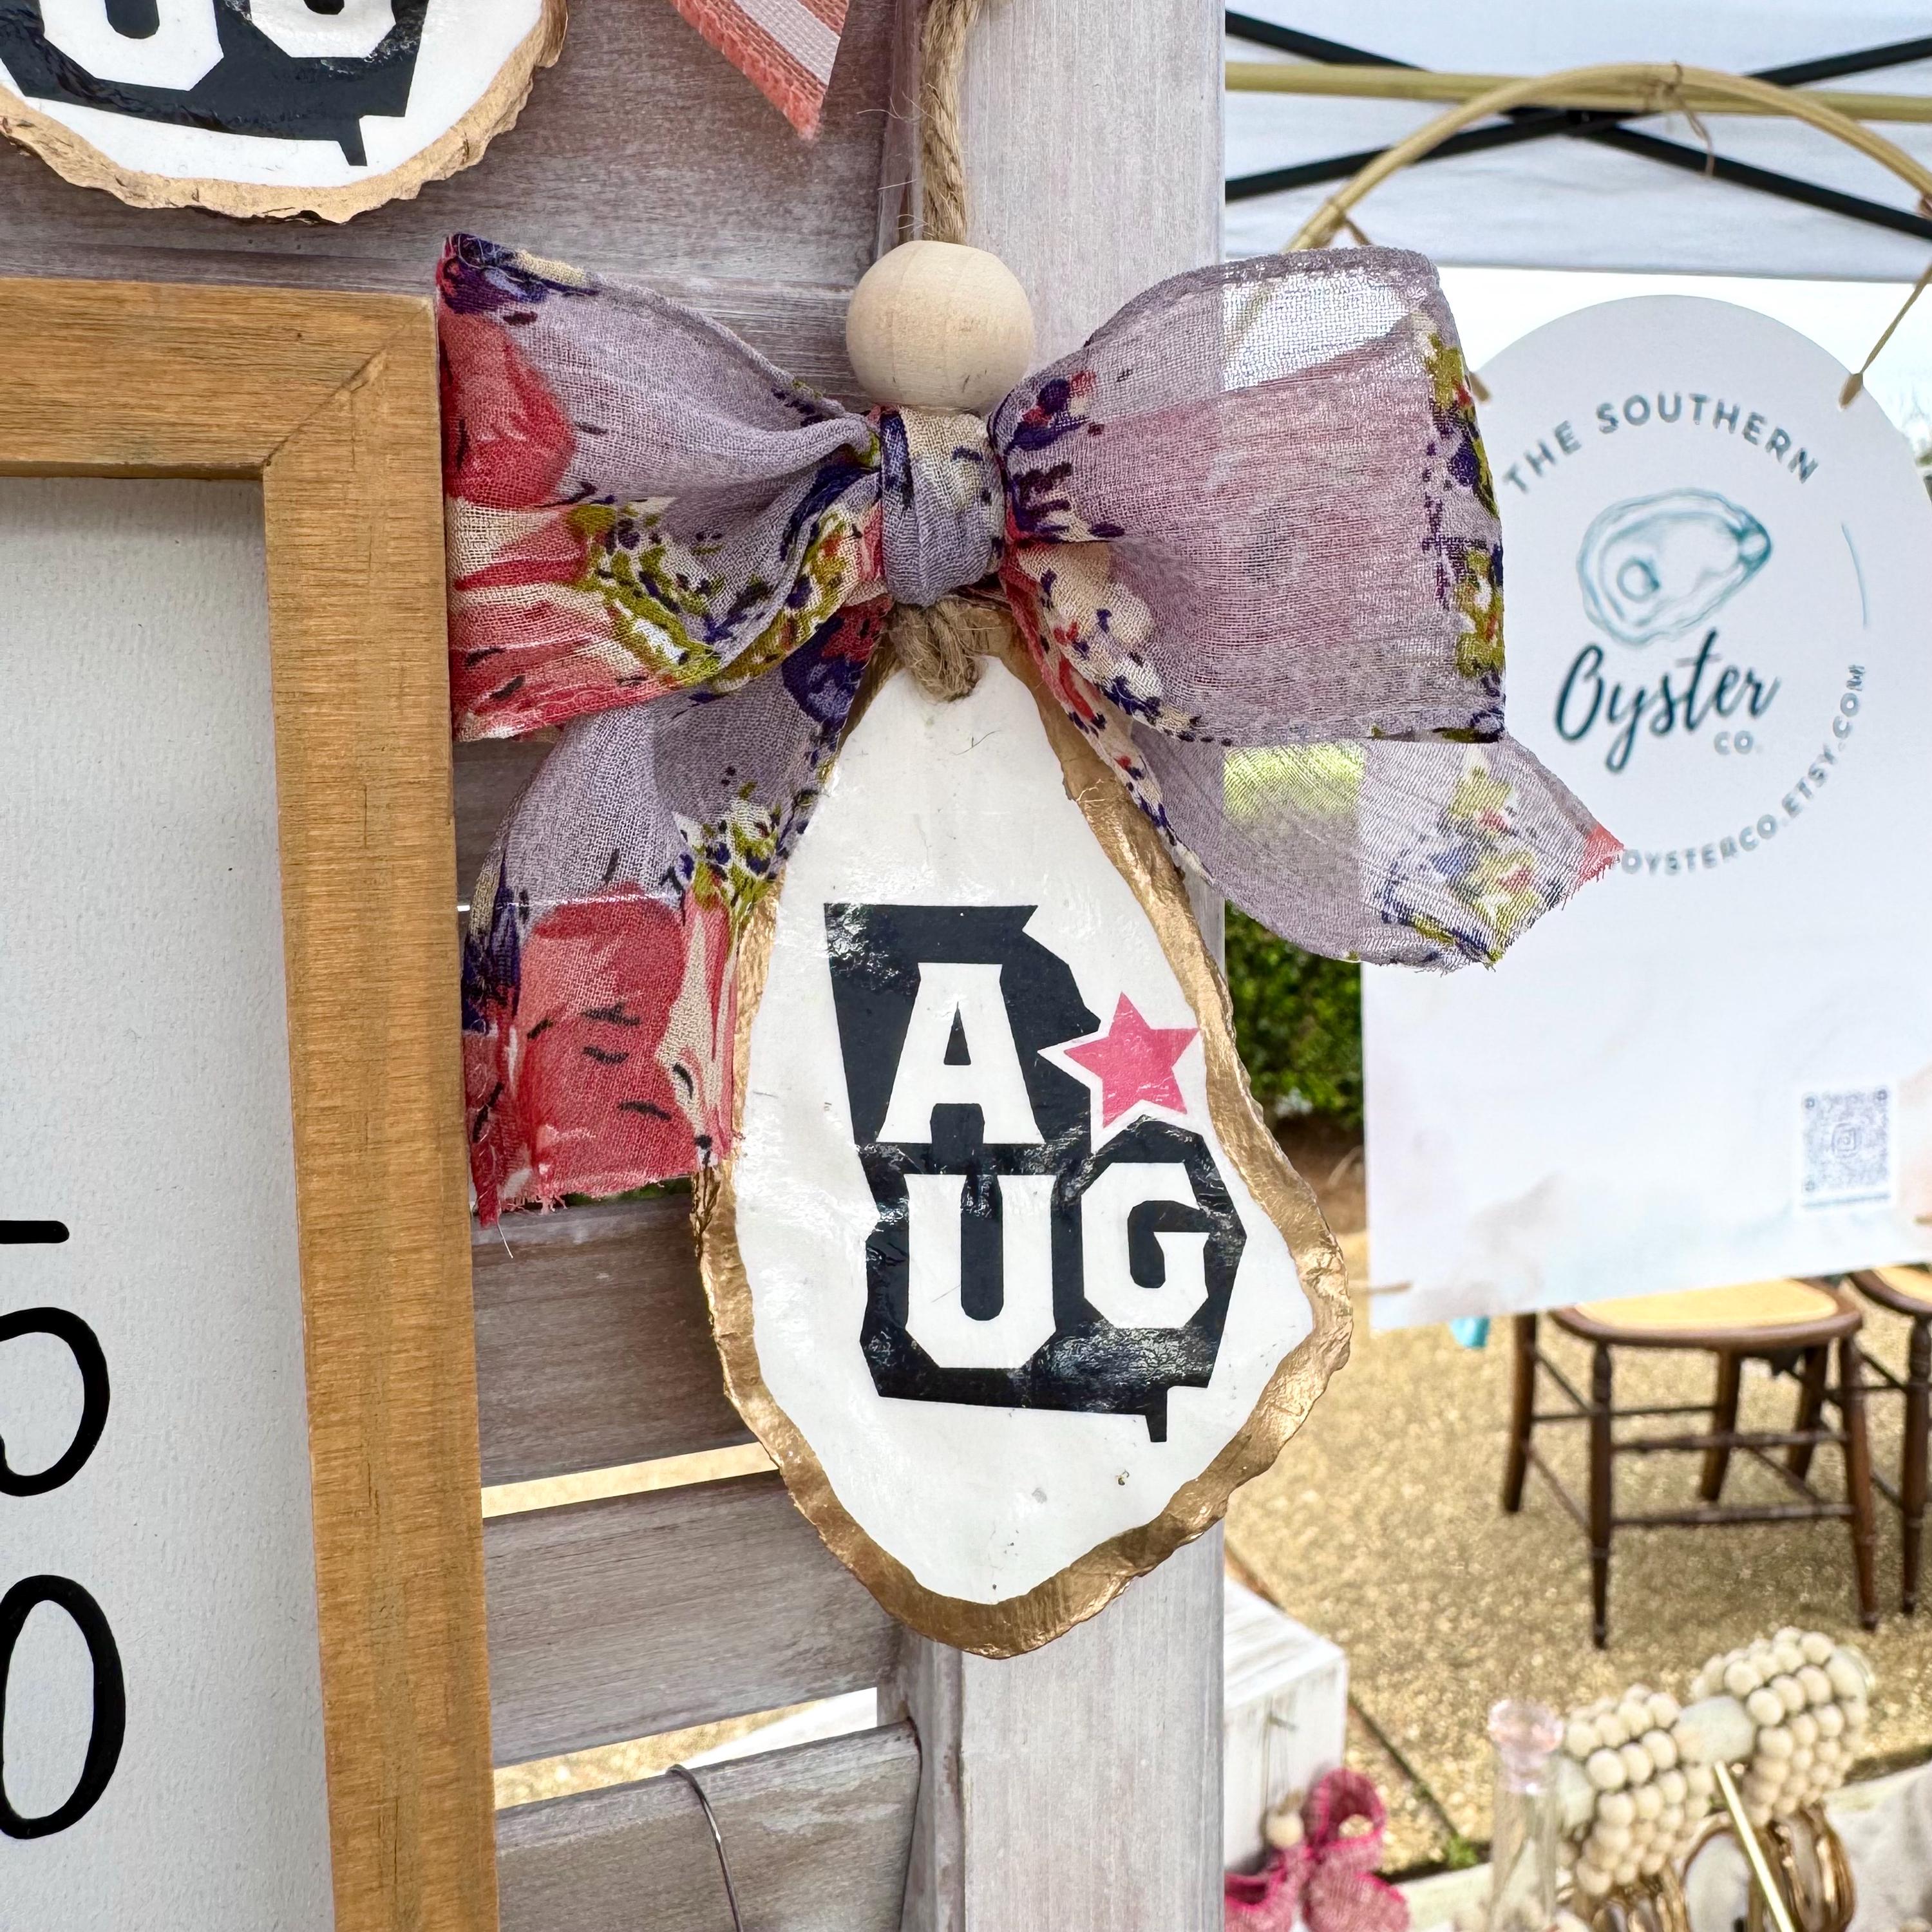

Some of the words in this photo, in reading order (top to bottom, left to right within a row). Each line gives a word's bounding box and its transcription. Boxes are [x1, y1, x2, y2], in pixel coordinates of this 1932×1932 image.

[1504, 421, 1583, 495] THE
[1595, 391, 1819, 484] SOUTHERN
[1553, 626, 1782, 773] Oyster
[876, 962, 1046, 1144] A
[903, 1162, 1210, 1370] UG
